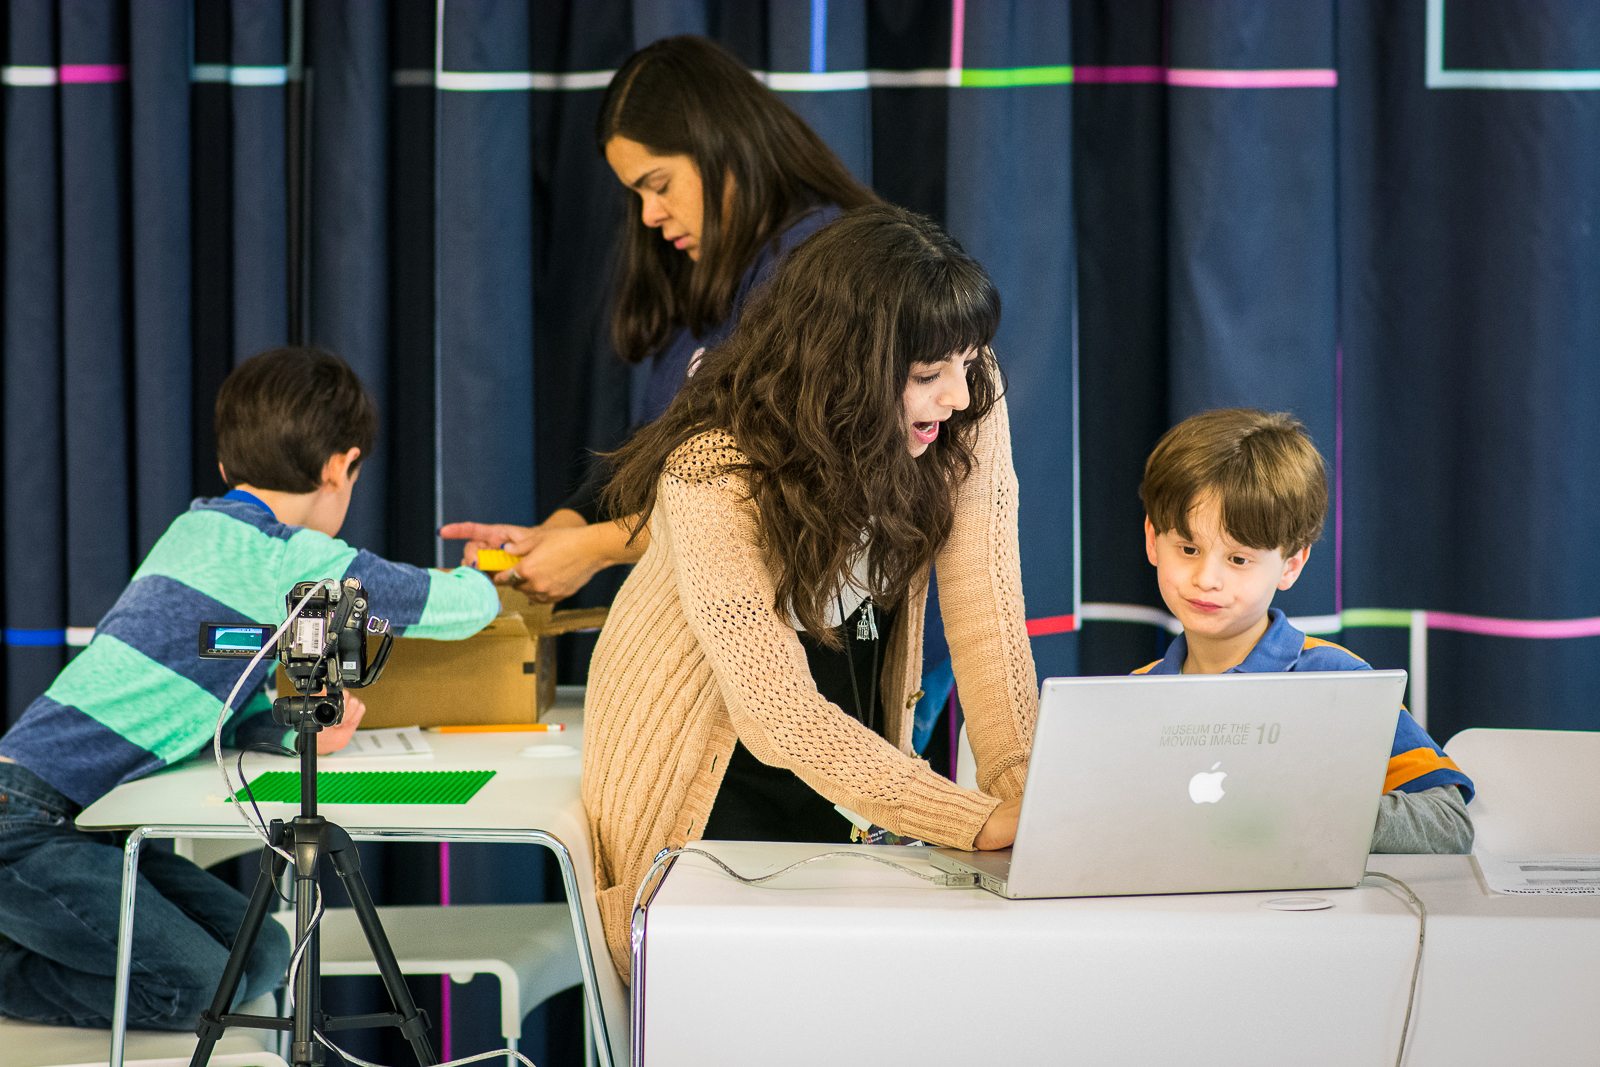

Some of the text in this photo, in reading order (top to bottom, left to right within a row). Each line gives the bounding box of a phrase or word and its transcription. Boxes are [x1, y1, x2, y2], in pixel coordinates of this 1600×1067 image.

[1161, 722, 1251, 736] MUSEUM OF THE
[1256, 722, 1281, 745] 10
[1159, 734, 1249, 747] MOVING IMAGE
